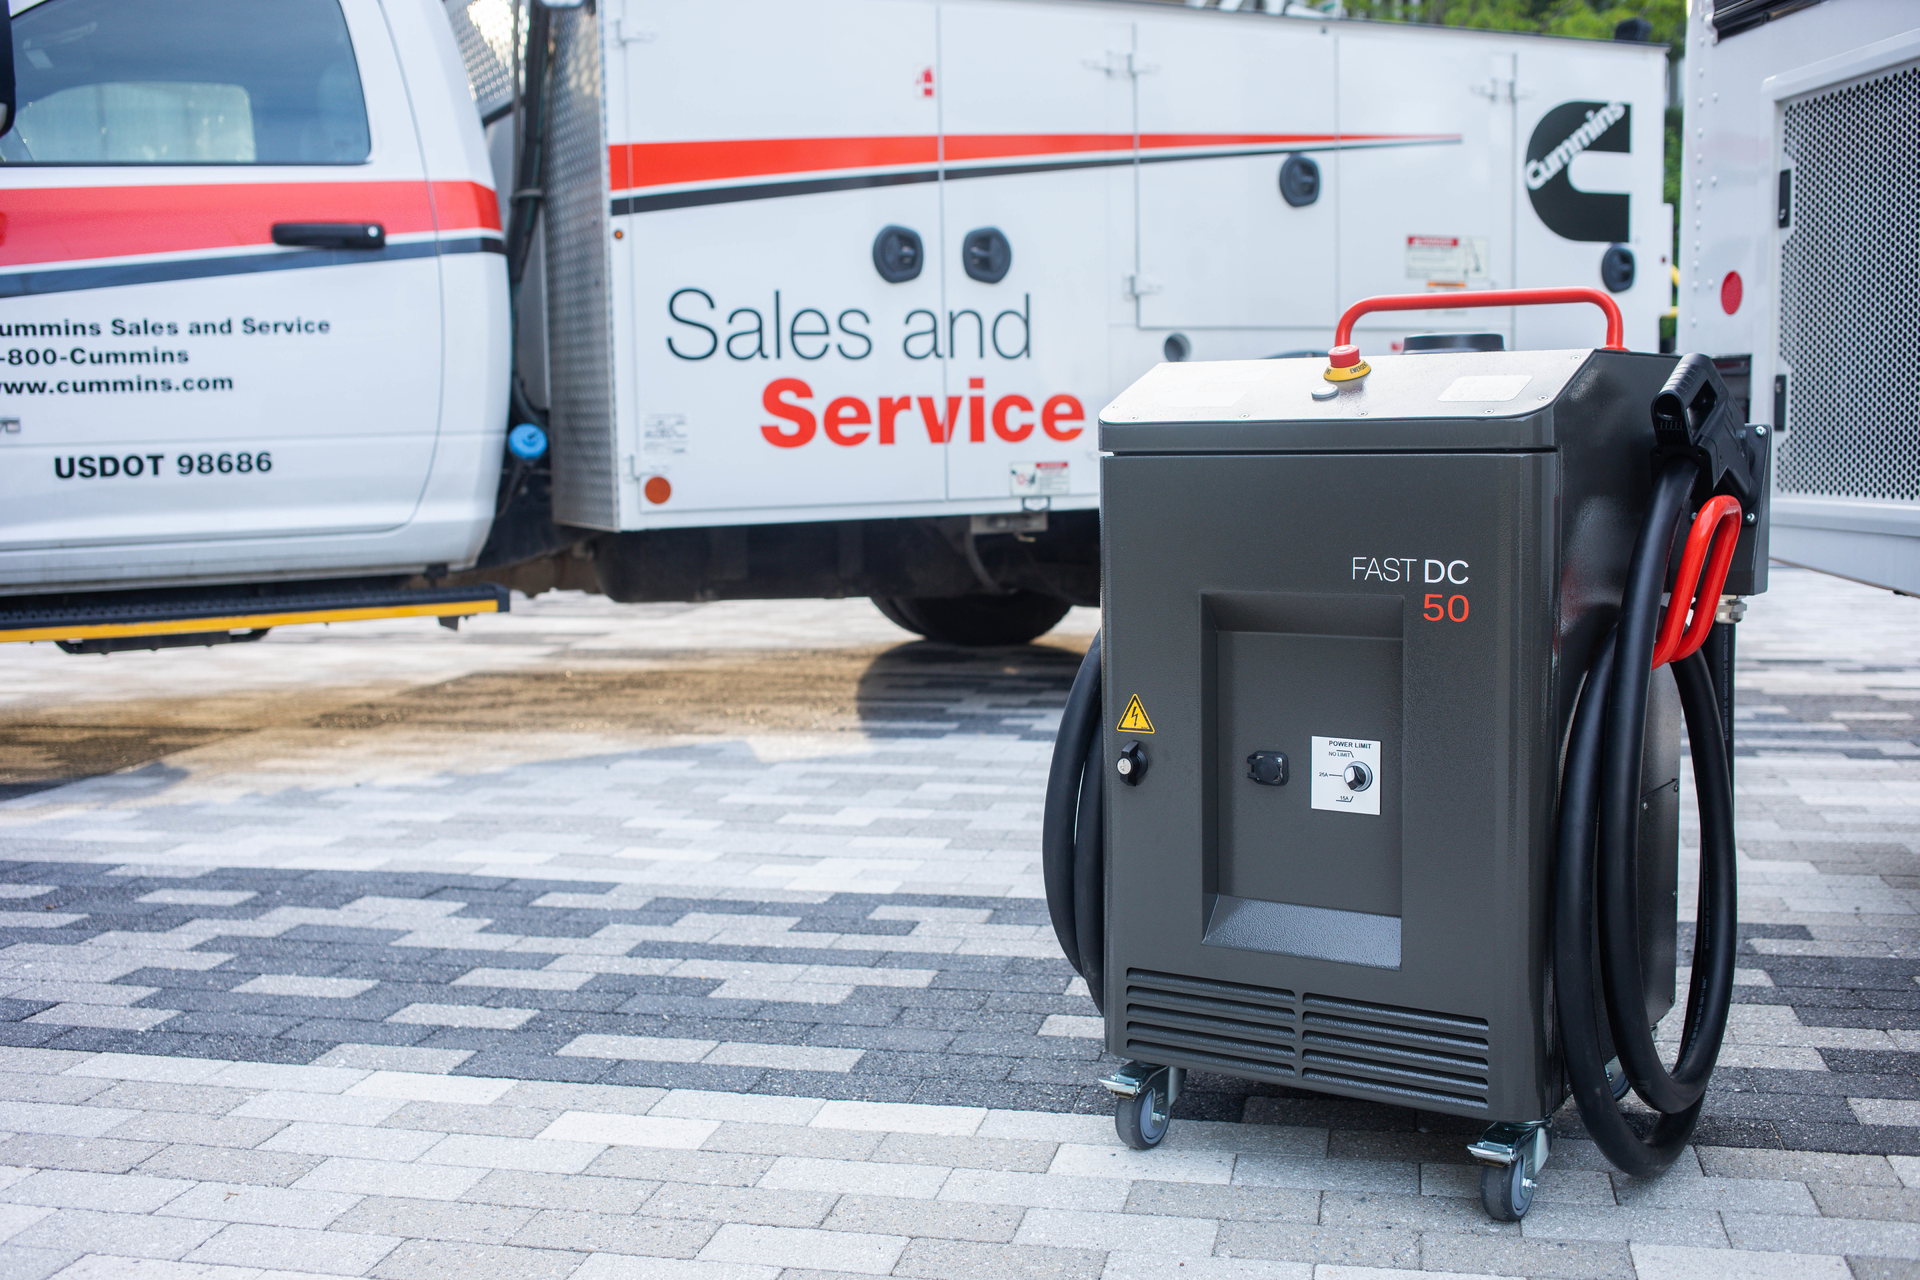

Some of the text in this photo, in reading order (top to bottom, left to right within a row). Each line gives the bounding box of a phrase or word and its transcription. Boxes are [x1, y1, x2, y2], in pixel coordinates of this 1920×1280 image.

[1526, 101, 1626, 190] Cummins
[111, 318, 179, 336] Sales
[189, 318, 233, 335] and
[242, 316, 331, 335] Service
[667, 287, 1031, 361] Sales and
[0, 346, 190, 366] -800-Cummins
[0, 375, 234, 395] ww.cummins.com
[760, 377, 1085, 449] Service
[54, 452, 273, 479] USDOT 98686
[1352, 556, 1469, 585] FAST DC
[1423, 593, 1469, 622] 50
[1328, 740, 1353, 748] POWER
